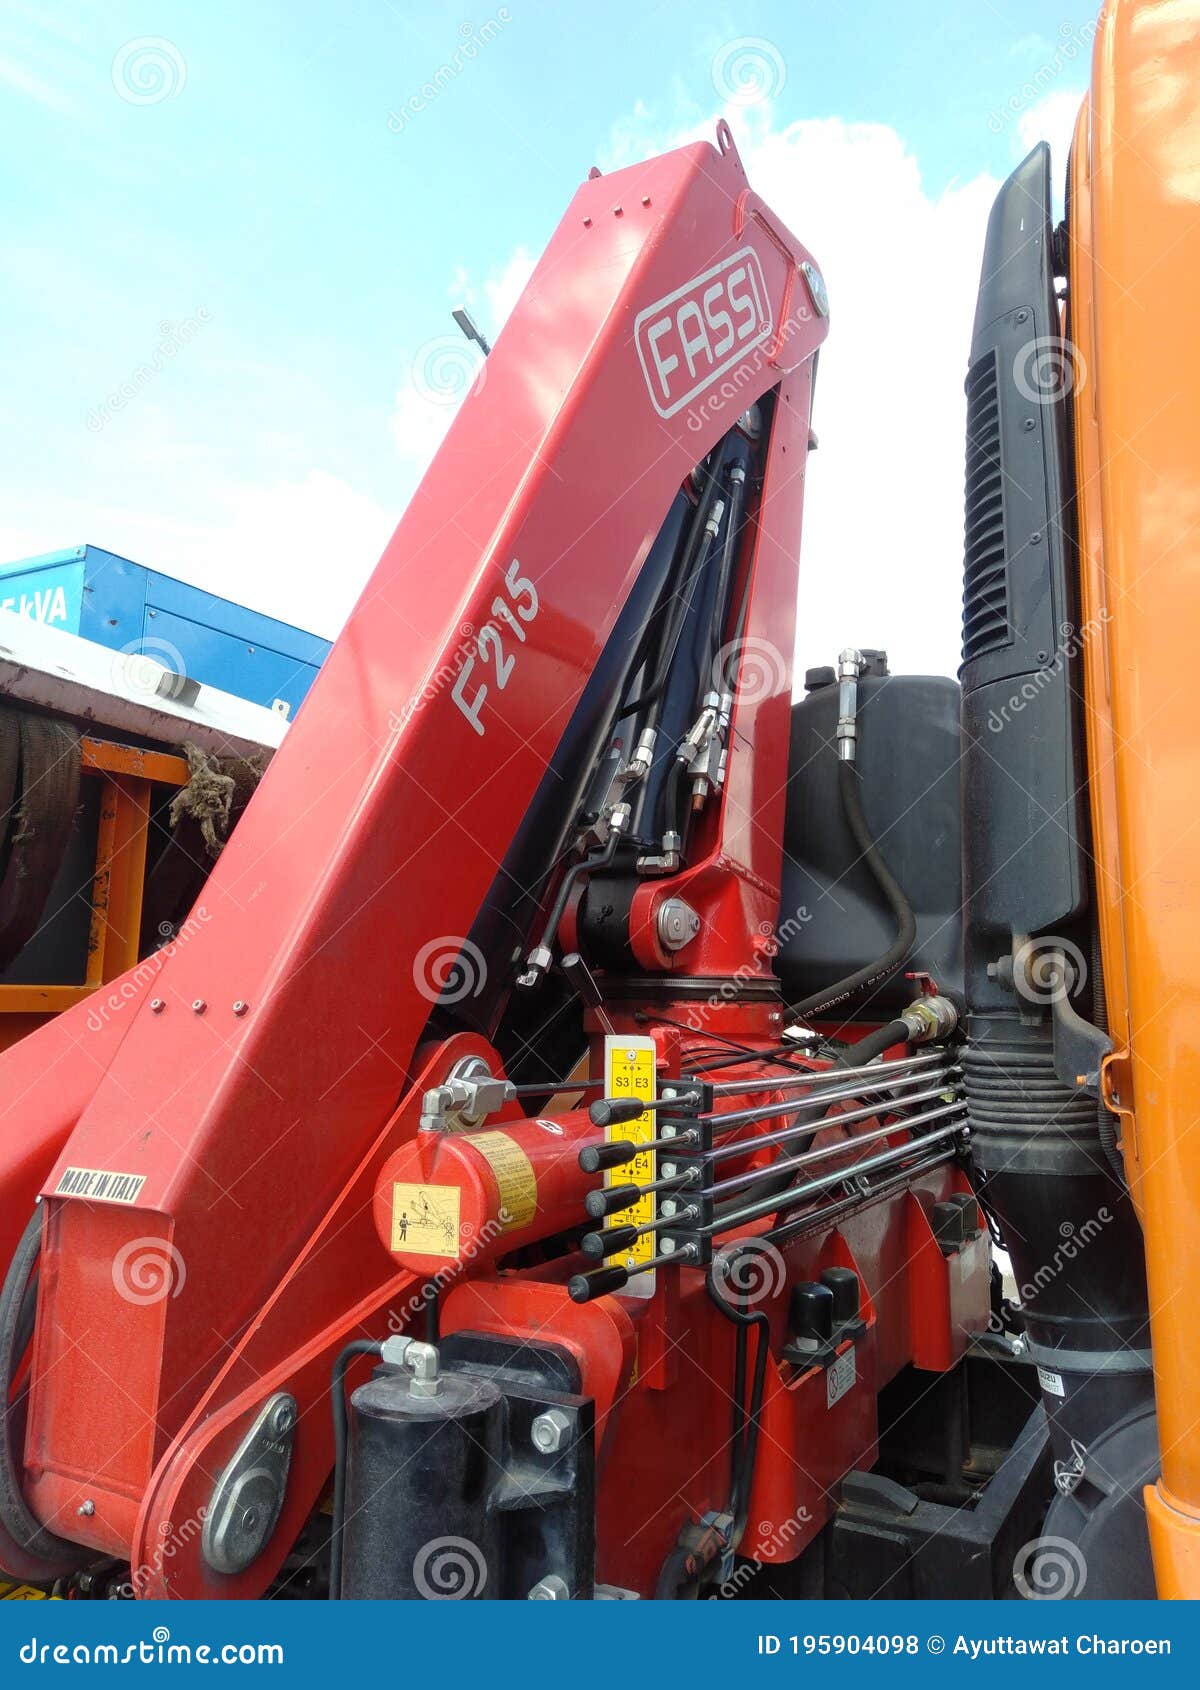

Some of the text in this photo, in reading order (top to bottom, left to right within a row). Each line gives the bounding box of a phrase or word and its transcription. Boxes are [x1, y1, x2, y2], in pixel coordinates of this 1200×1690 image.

[647, 262, 765, 399] FASSI
[451, 558, 539, 737] F215
[615, 1076, 649, 1089] S3 E3
[635, 1158, 648, 1169] E4
[57, 1169, 143, 1201] MADE IN ITALY
